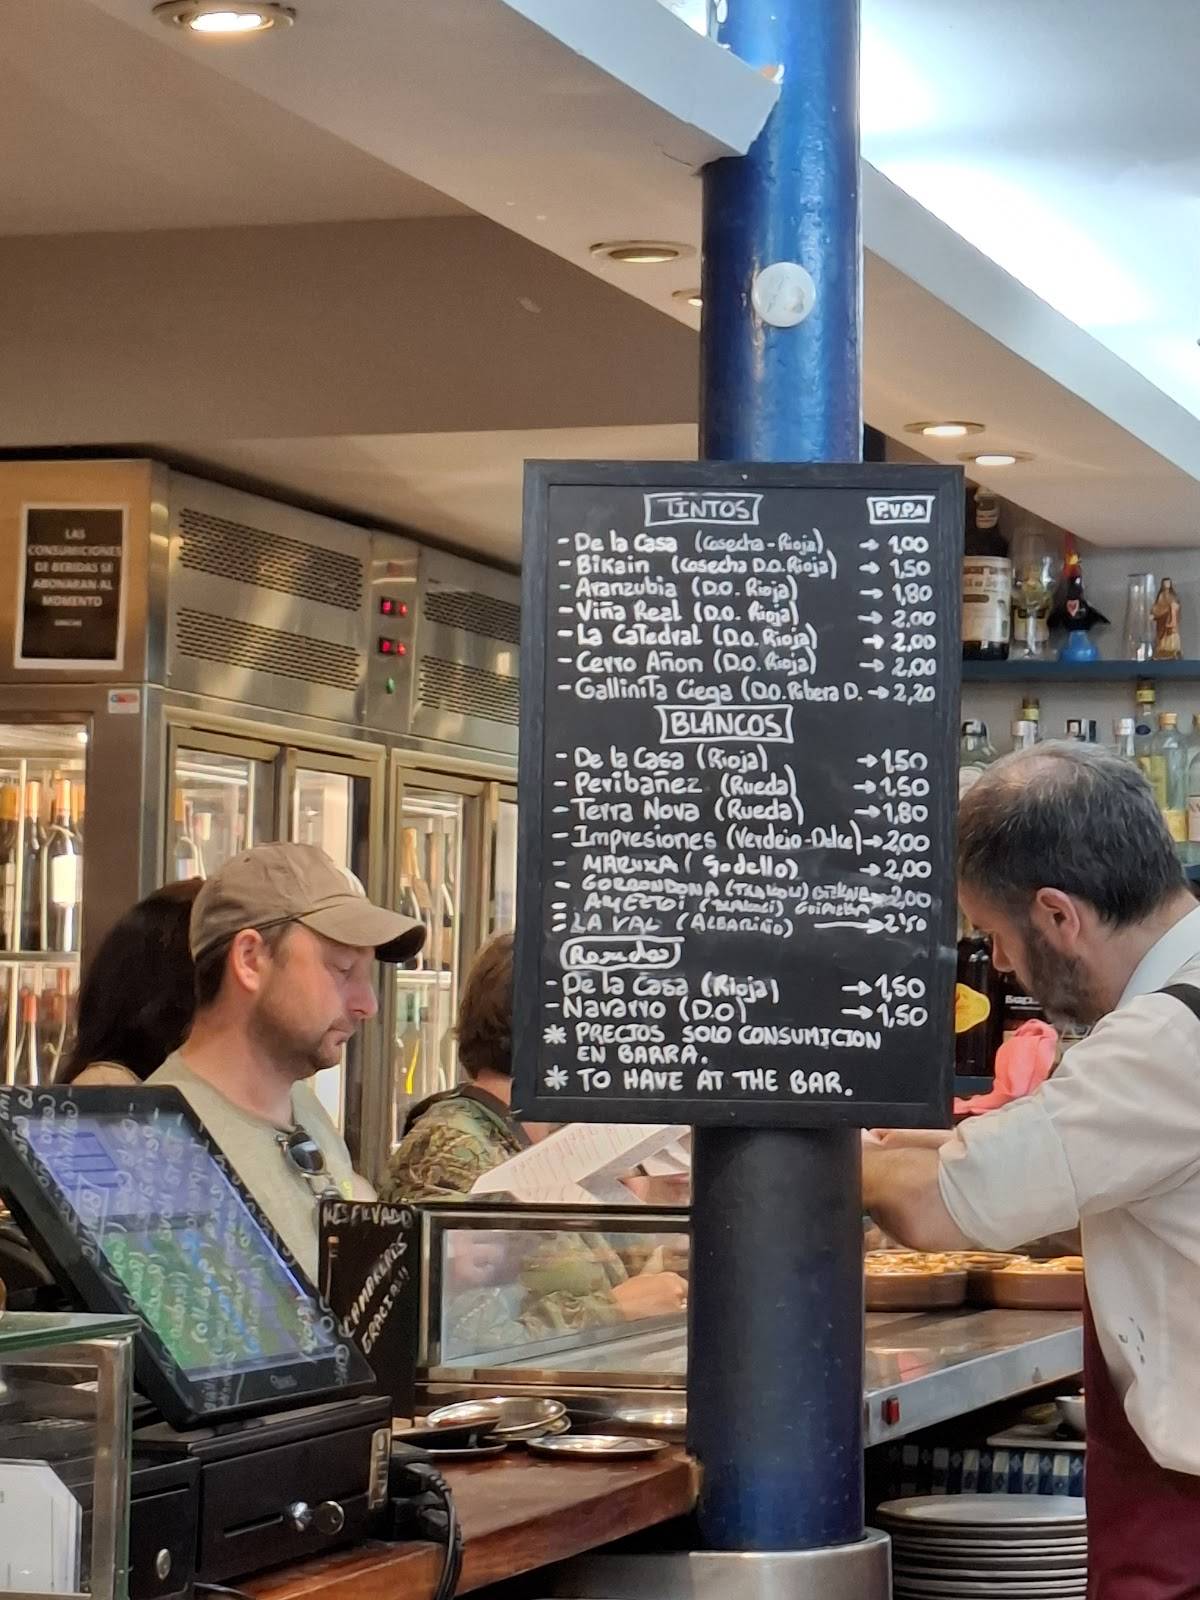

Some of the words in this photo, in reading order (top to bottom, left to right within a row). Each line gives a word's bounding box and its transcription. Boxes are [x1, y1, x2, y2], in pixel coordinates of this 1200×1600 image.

[657, 497, 751, 519] TINTOS
[65, 528, 86, 540] LAS
[574, 532, 604, 552] De
[610, 529, 628, 553] la
[634, 533, 678, 553] Casa
[42, 596, 103, 608] MOMENTO
[576, 576, 678, 598] Aranzubia
[892, 583, 933, 606] 1,80
[576, 600, 626, 621] Viña
[634, 600, 682, 621] Real
[577, 623, 602, 646] La
[576, 651, 637, 673] Cerro
[646, 650, 703, 673] Añon
[676, 679, 733, 706] Ciega
[893, 683, 936, 706] 2,20
[671, 711, 783, 737] BLANCOS
[574, 747, 603, 769] De
[610, 745, 628, 768] la
[634, 747, 684, 770] Casa
[697, 744, 767, 773] (Rioja)
[575, 770, 702, 796] Peribañez
[721, 764, 796, 798] (Rueda)
[570, 798, 633, 822] Terra
[644, 797, 700, 821] Nova
[714, 796, 804, 825] (Rueda)
[882, 801, 928, 825] 1,80
[571, 825, 717, 851] Impresiones
[570, 912, 602, 933] LA
[612, 915, 662, 934] VAL
[562, 972, 596, 995] De
[602, 970, 624, 995] la
[632, 973, 689, 996] Casa
[875, 974, 926, 1002] 1,50
[563, 996, 666, 1019] Navarro
[876, 1003, 928, 1028] 1,50
[575, 1022, 666, 1045] PRECIOS
[682, 1026, 732, 1043] SOLO
[738, 1026, 881, 1050] CONSUMICION
[577, 1046, 606, 1063] EN
[617, 1044, 708, 1064] BARRA.
[576, 1068, 612, 1092] TO
[623, 1069, 683, 1091] HAVE
[696, 1070, 724, 1091] AT
[732, 1069, 779, 1091] THE
[789, 1070, 853, 1096] BAR.
